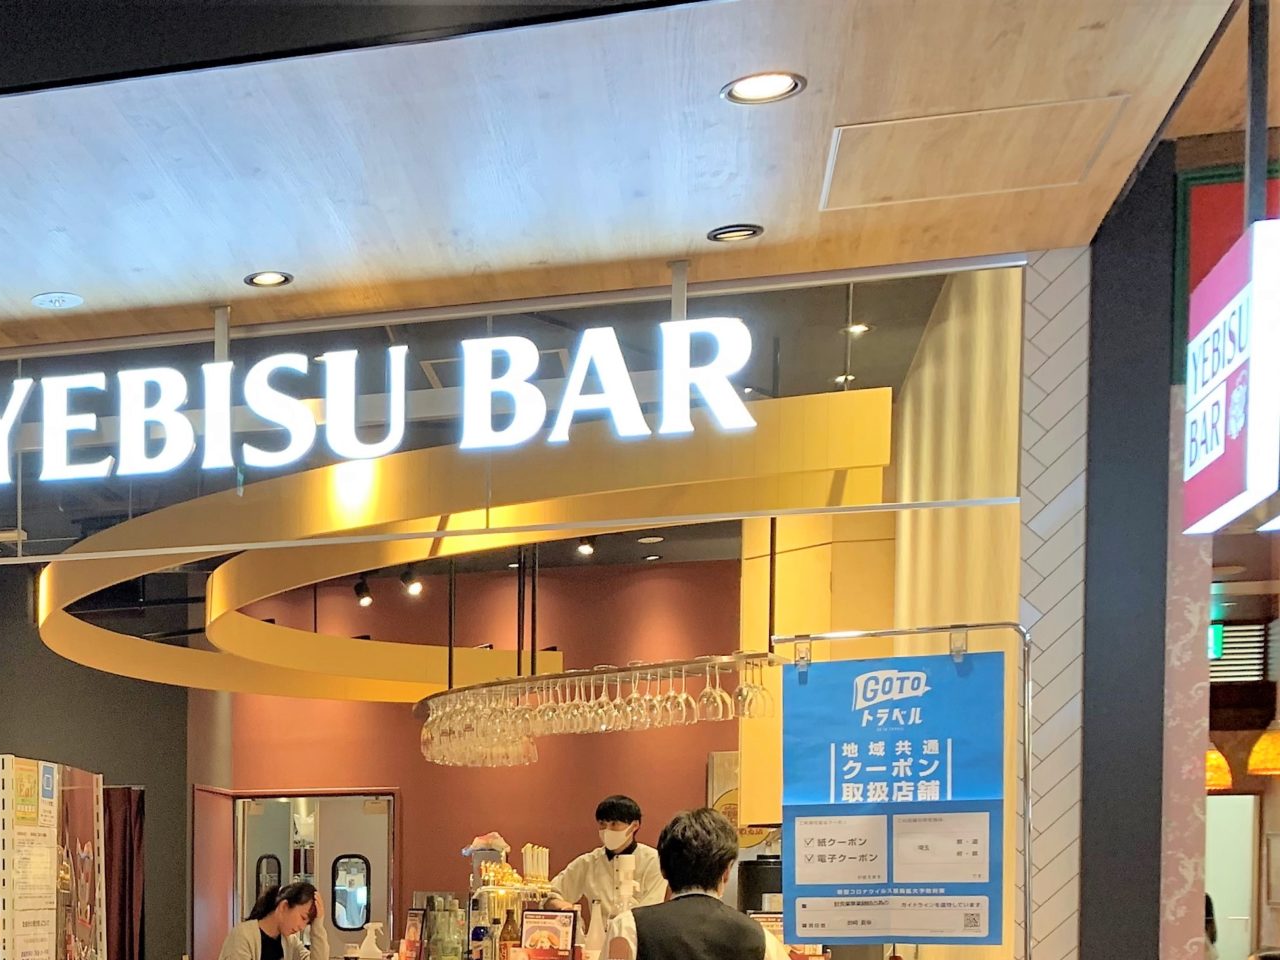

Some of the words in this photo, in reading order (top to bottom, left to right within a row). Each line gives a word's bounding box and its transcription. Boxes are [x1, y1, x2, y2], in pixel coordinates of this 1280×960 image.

[1192, 297, 1250, 394] YEBISU
[459, 317, 758, 450] BAR
[1189, 400, 1221, 468] BAR
[861, 707, 923, 727] トラベル
[841, 739, 940, 758] 地域共通
[842, 758, 940, 780] クーポン
[841, 779, 940, 803] 取扱店舗
[817, 838, 868, 848] 紙クーポン
[817, 853, 879, 864] 電子クーポン
